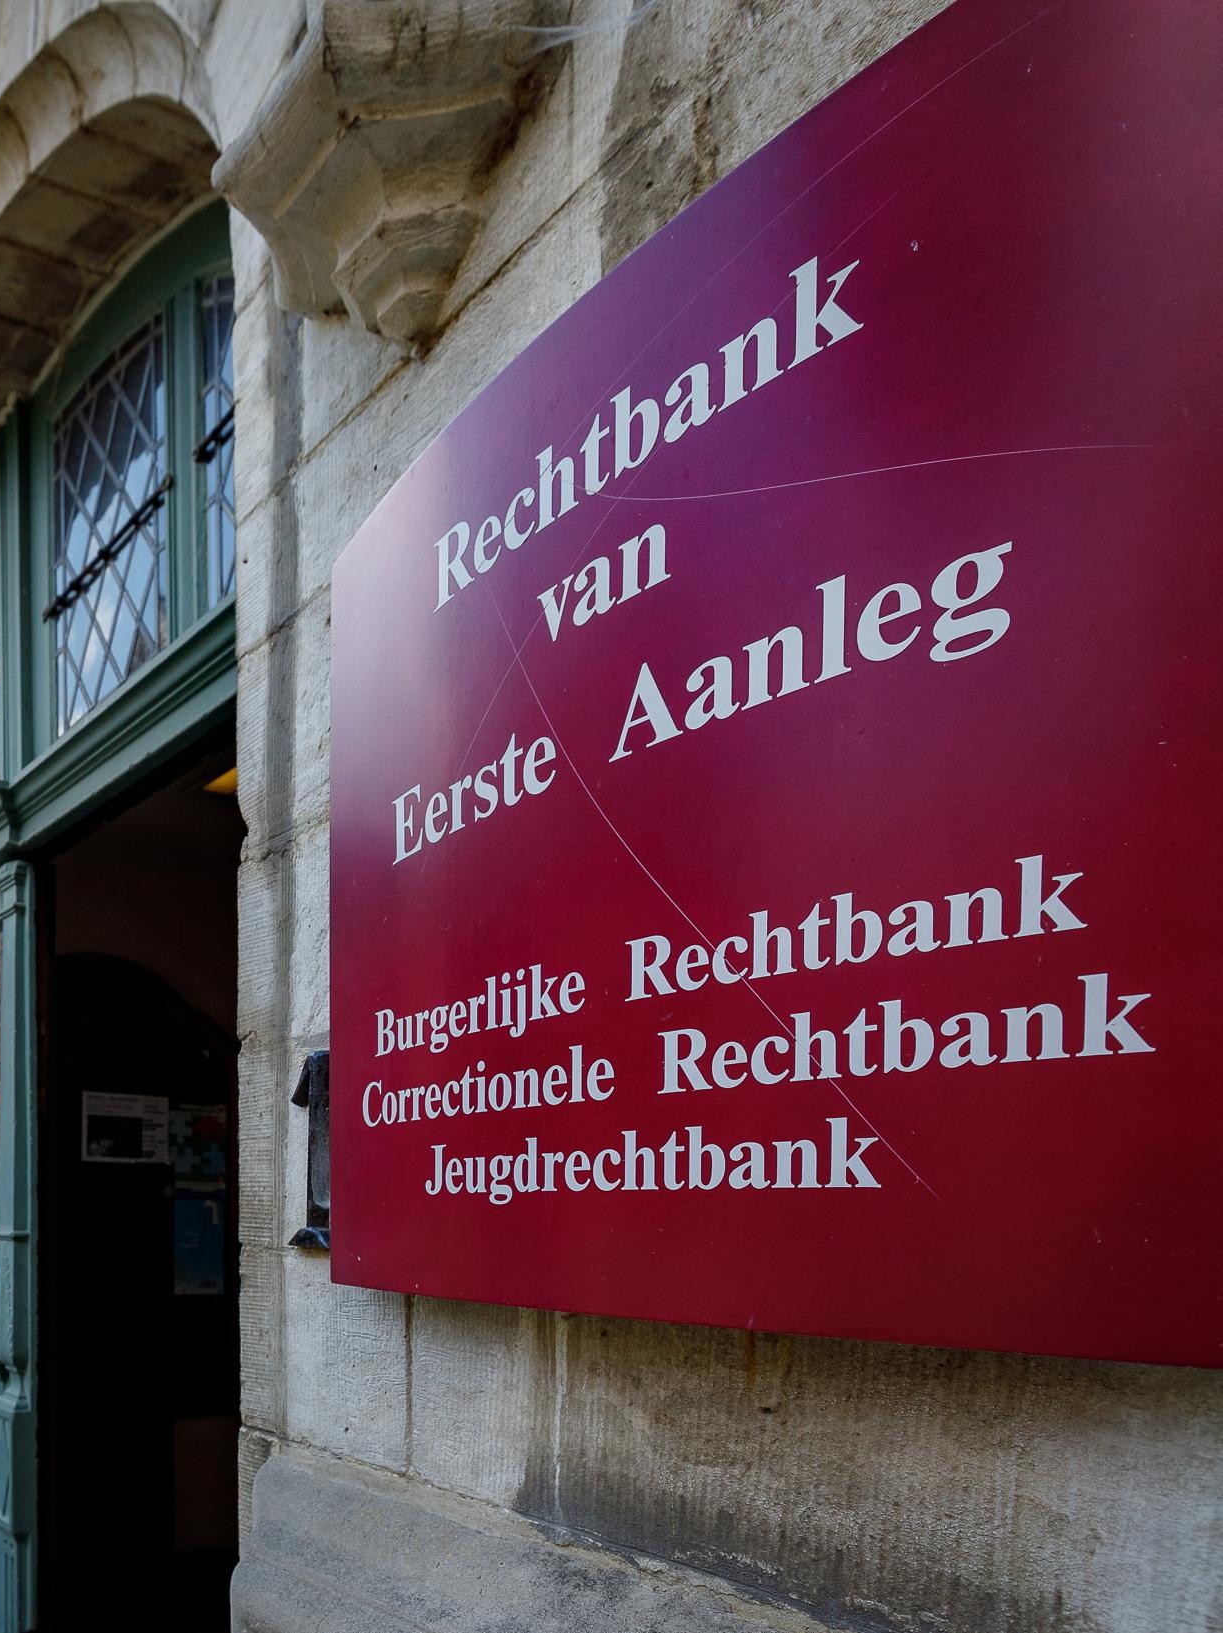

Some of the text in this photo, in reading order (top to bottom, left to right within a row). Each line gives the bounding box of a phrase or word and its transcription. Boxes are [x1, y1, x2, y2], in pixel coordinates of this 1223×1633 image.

[432, 256, 864, 613] Rechtbank
[536, 524, 672, 642] van
[391, 542, 1013, 866] Eerste Aanleg
[374, 855, 1088, 1058] Burgerlijke Rechtbank
[362, 974, 1156, 1128] Correctionele Rechtbank
[425, 1118, 882, 1206] Jeugdrechtbank
